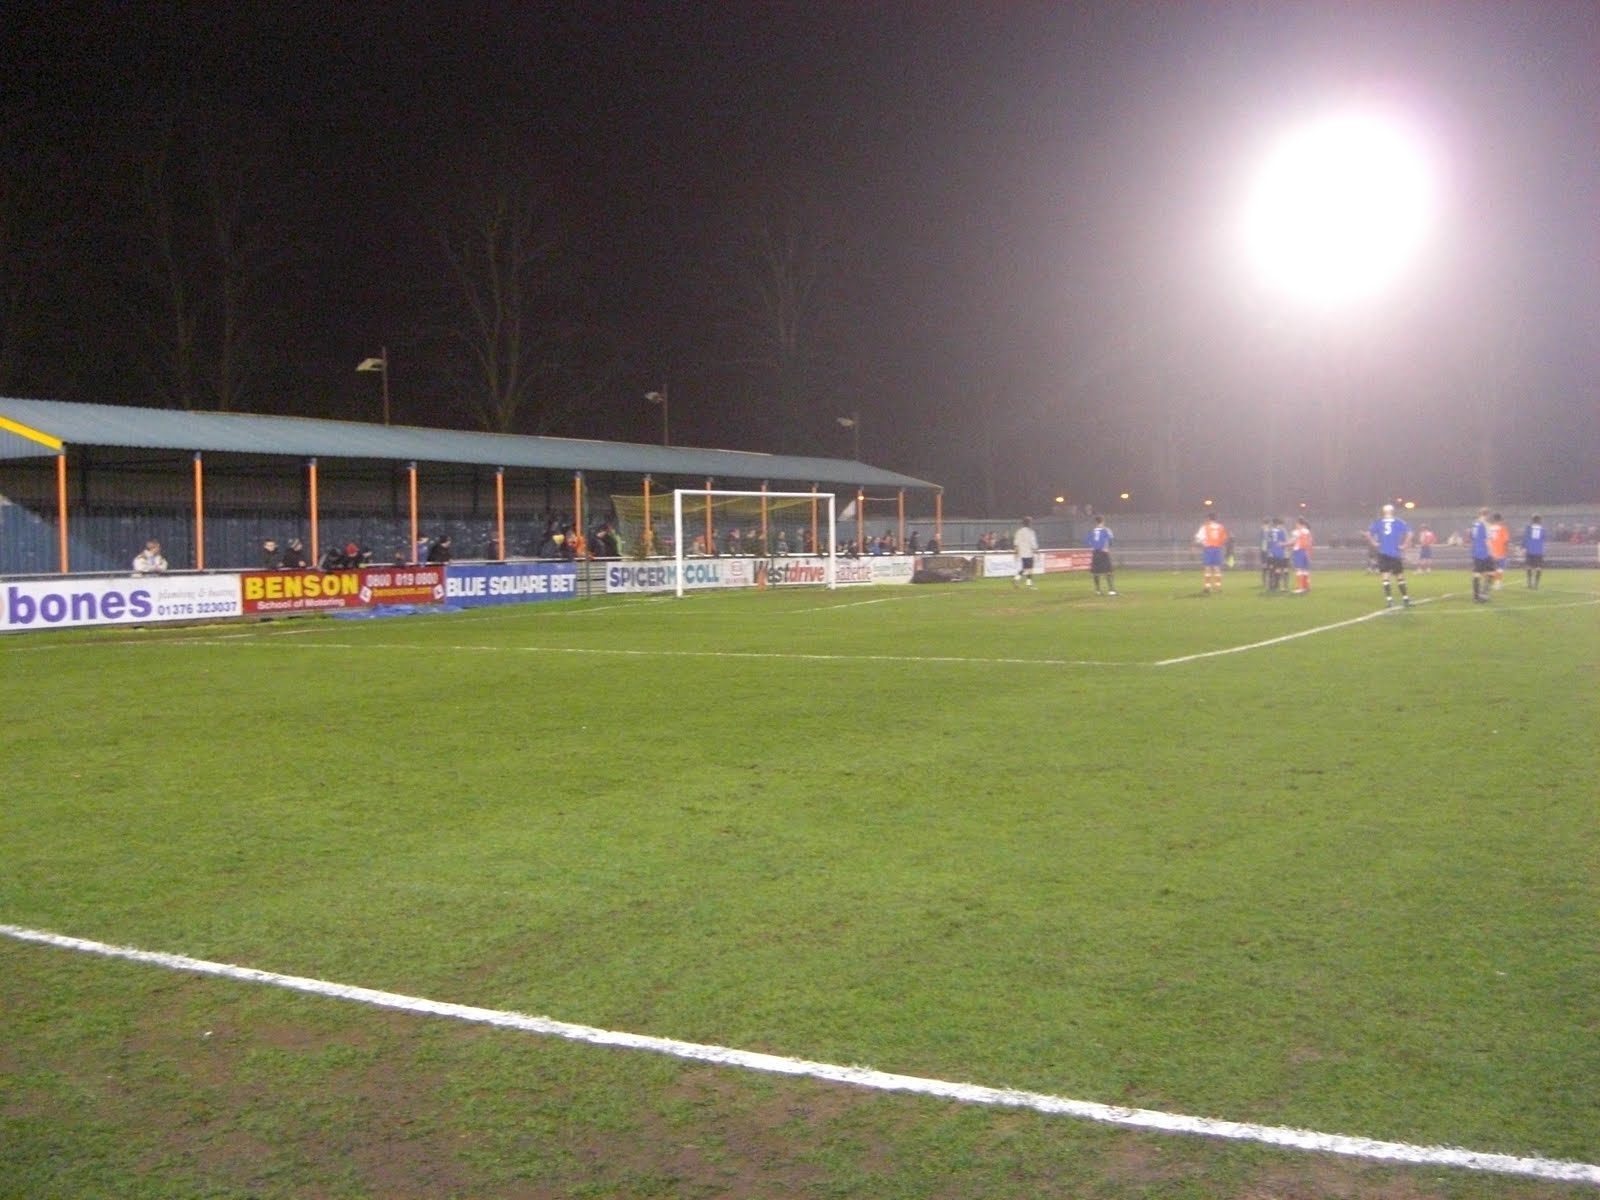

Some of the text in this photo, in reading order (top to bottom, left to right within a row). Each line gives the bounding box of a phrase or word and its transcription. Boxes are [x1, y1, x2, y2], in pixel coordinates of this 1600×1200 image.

[245, 574, 359, 600] BENSON
[447, 576, 486, 597] BLUE
[488, 575, 548, 595] SQUARE
[550, 574, 576, 592] BET
[8, 587, 152, 624] bones
[158, 603, 193, 616] 01376
[257, 600, 292, 610] School
[293, 599, 304, 608] of
